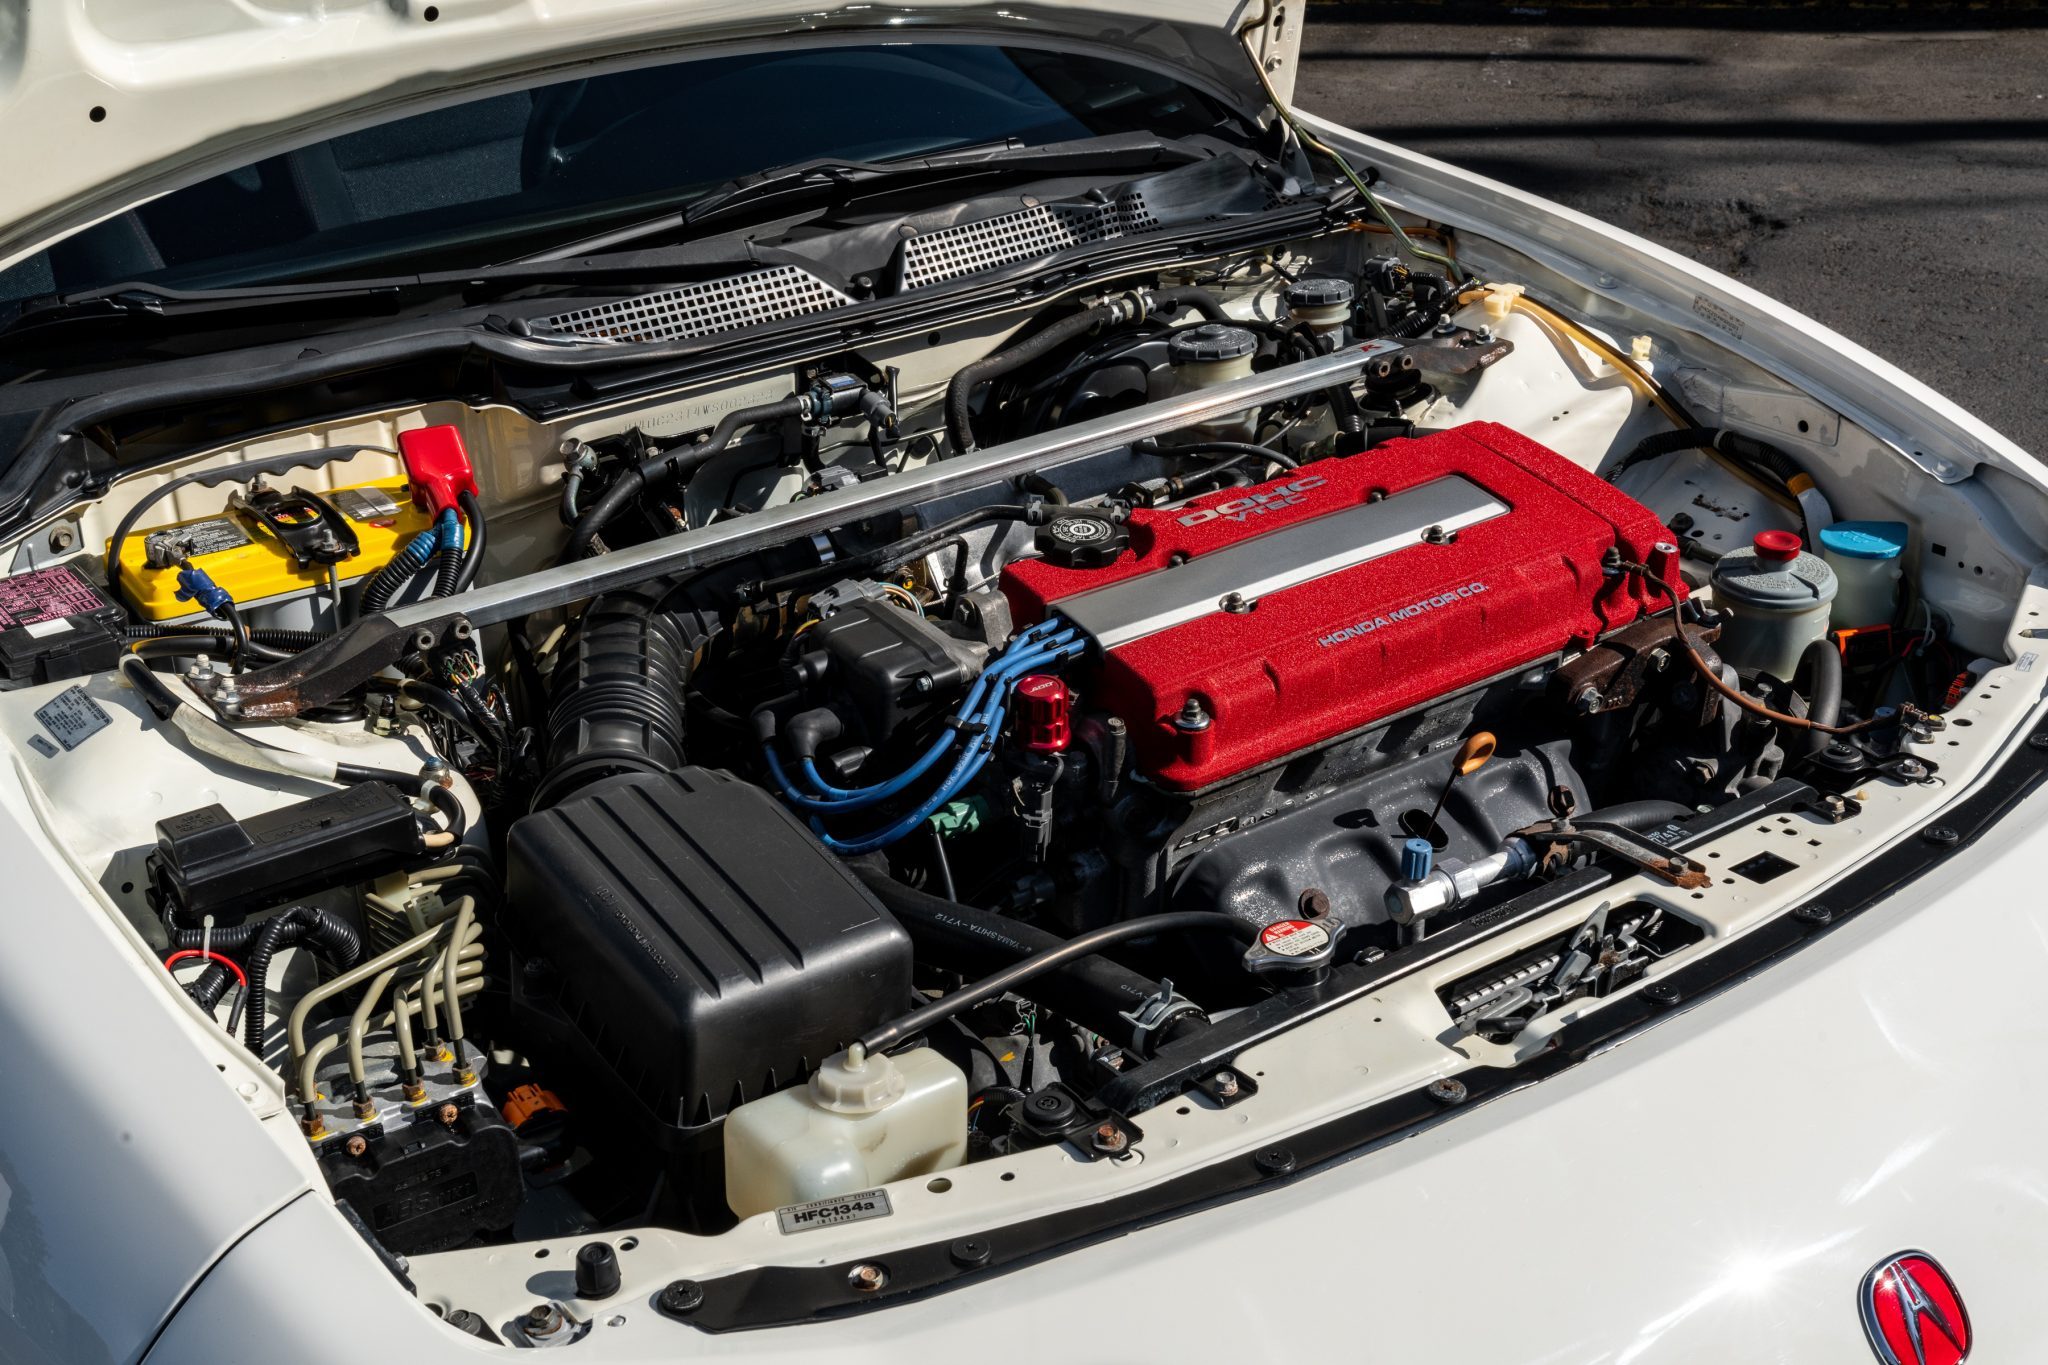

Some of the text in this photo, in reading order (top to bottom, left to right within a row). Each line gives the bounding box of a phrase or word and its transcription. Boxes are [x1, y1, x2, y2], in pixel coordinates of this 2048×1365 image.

[1176, 475, 1327, 527] DOHC
[1224, 494, 1308, 522] VTEC
[1316, 581, 1490, 648] HONDA MOTOR CO.
[794, 1202, 875, 1224] HFC134a
